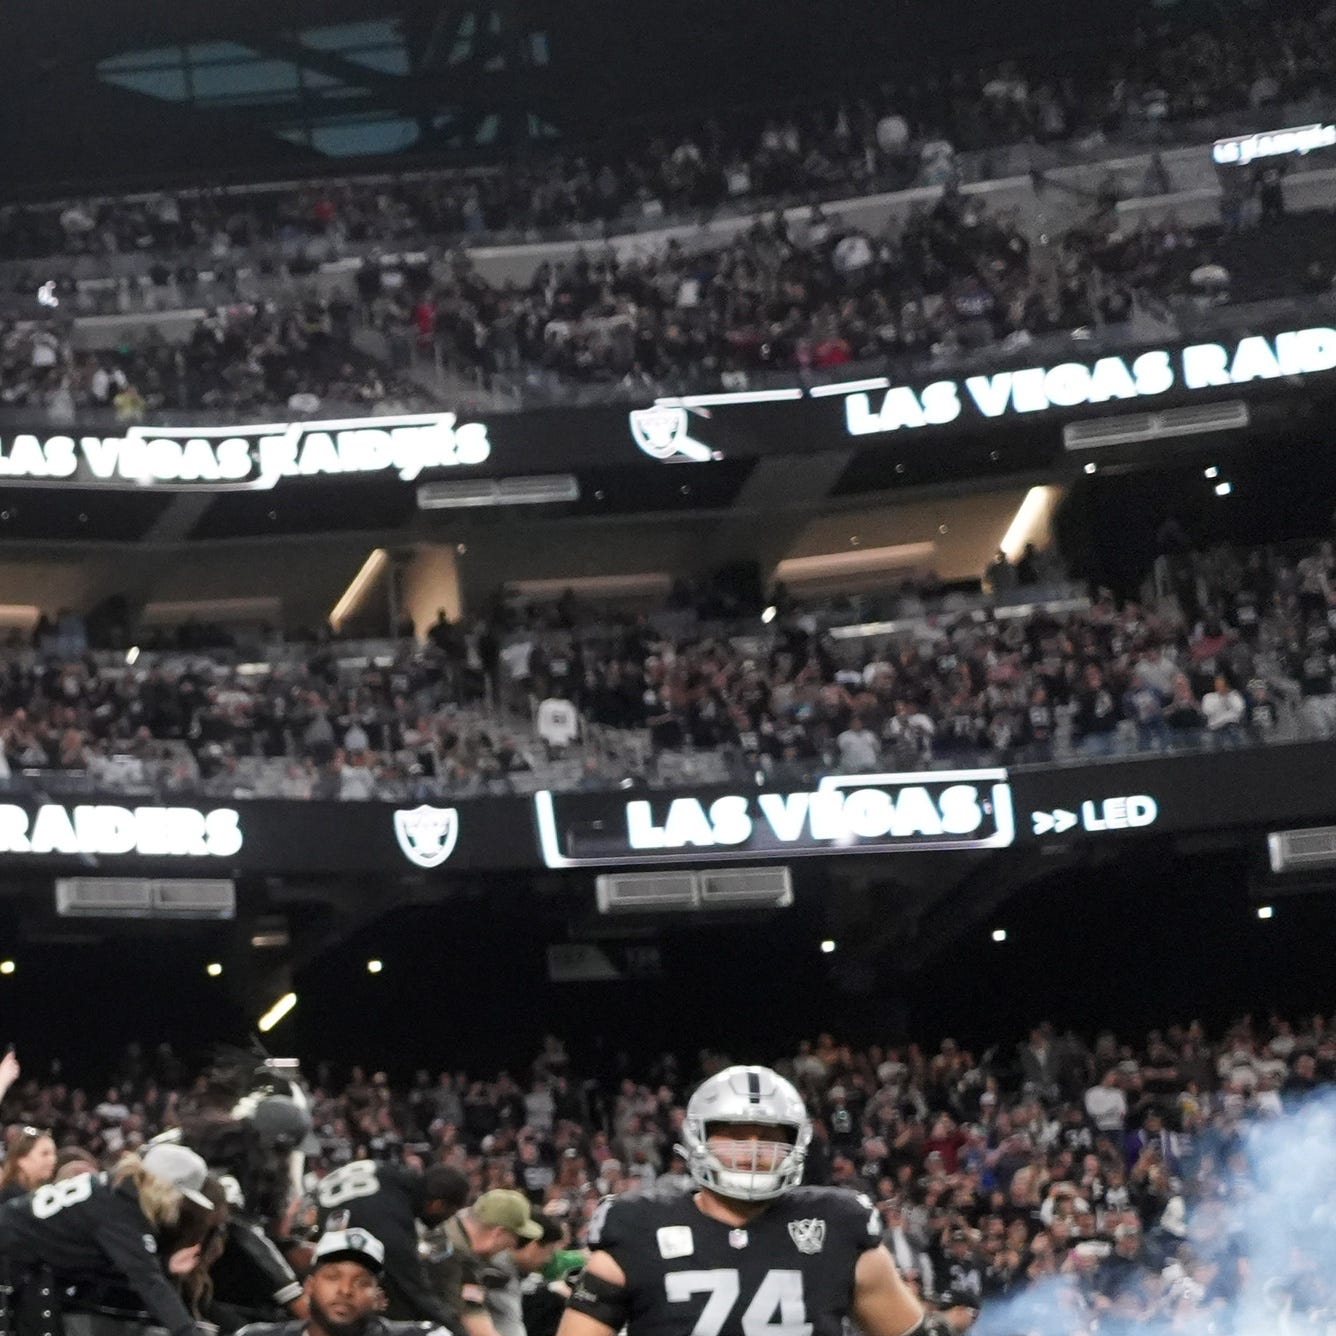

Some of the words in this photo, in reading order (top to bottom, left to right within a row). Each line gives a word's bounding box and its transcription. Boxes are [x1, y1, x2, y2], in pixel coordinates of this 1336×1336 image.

[845, 380, 962, 436] LAS
[965, 350, 1175, 417] VEGAS
[80, 436, 253, 481] VEGAS
[626, 796, 753, 850] LAS
[758, 784, 984, 842] VEGAS
[1082, 795, 1157, 832] LED
